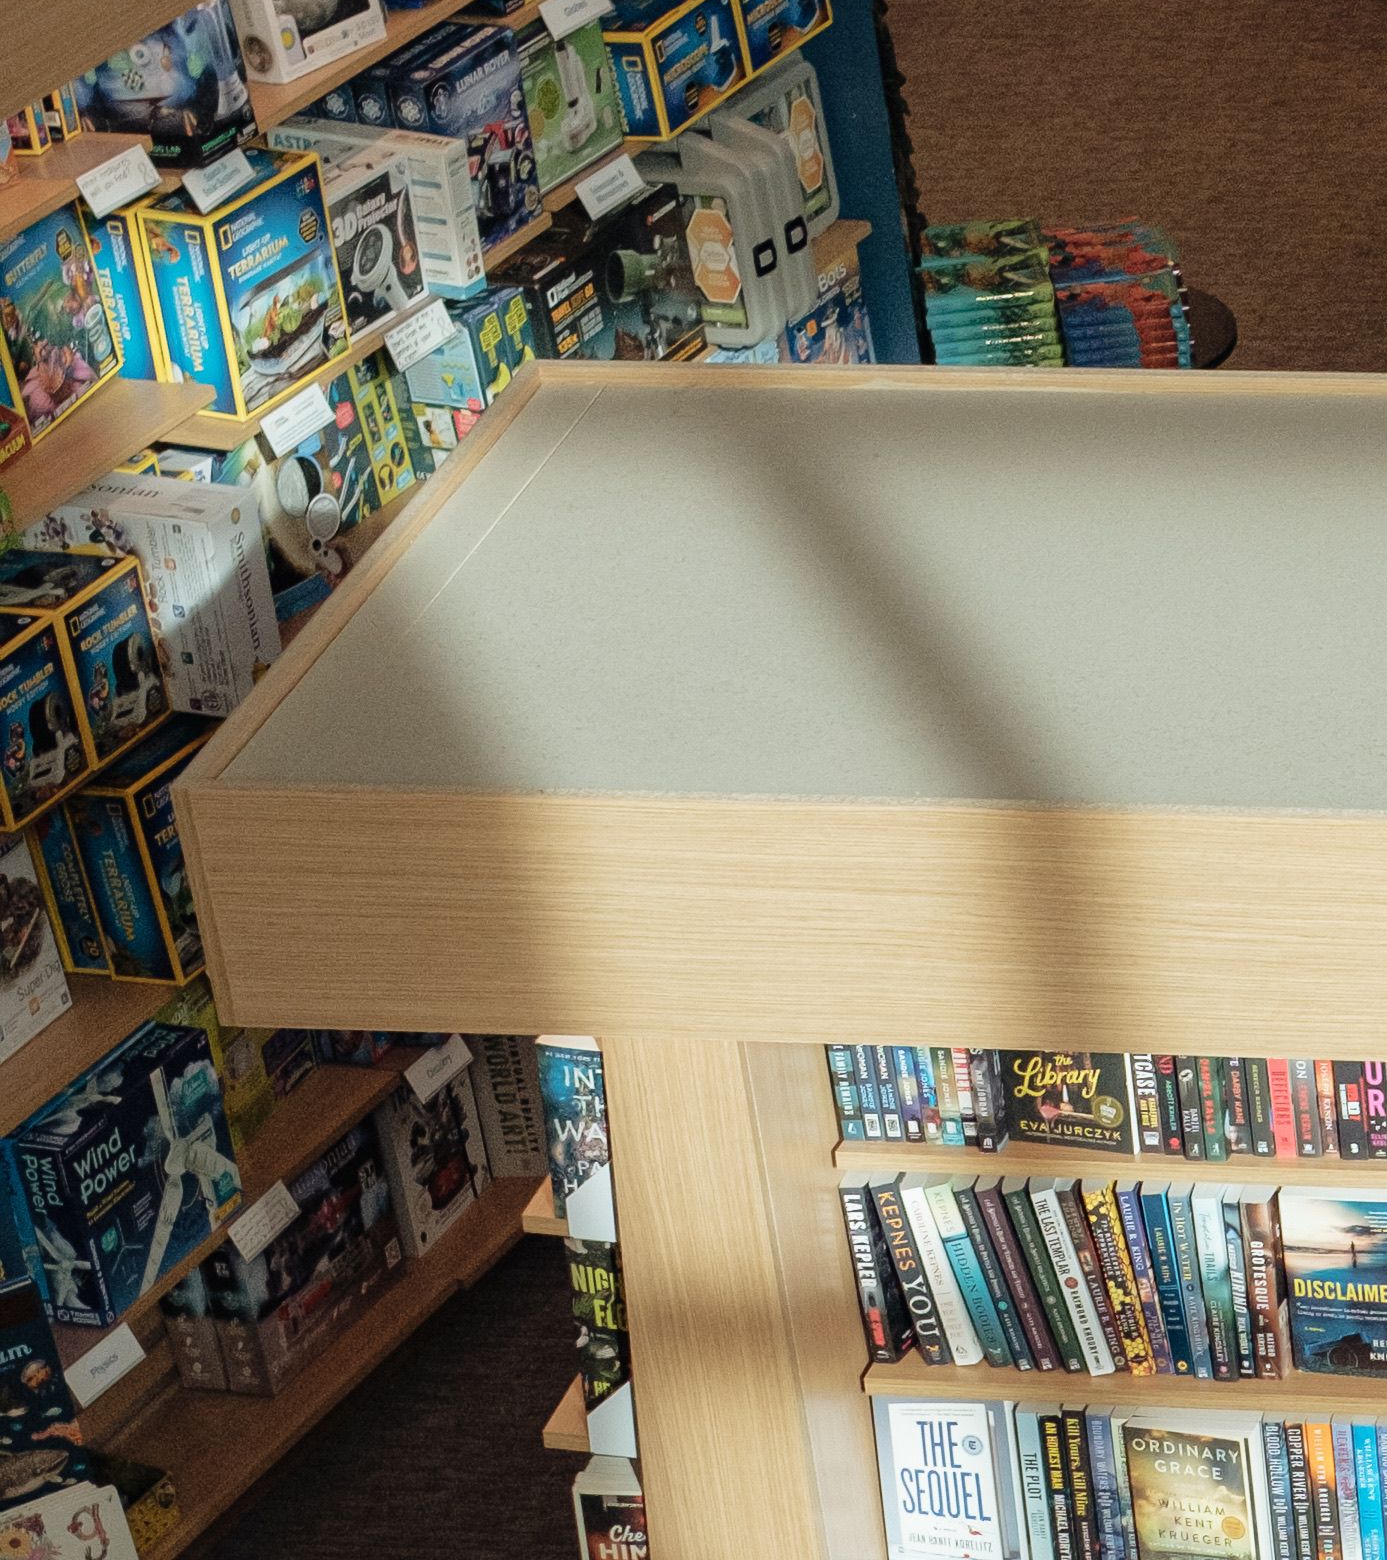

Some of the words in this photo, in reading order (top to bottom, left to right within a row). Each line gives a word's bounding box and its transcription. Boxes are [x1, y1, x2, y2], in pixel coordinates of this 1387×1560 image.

[455, 66, 485, 94] LUNAR
[331, 211, 358, 248] 3D
[227, 234, 290, 281] TERRARIUM
[233, 531, 261, 651] Smithsonian
[1013, 1056, 1101, 1099] Library
[842, 1193, 867, 1232] LARS
[851, 1234, 877, 1289] KEPLER
[877, 1190, 917, 1272] KEPNES
[901, 1274, 940, 1337] YOU
[915, 1420, 962, 1469] THE
[1132, 1438, 1240, 1464] ORDINARY
[1154, 1459, 1223, 1481] GRACE
[900, 1468, 992, 1522] SEQUEL
